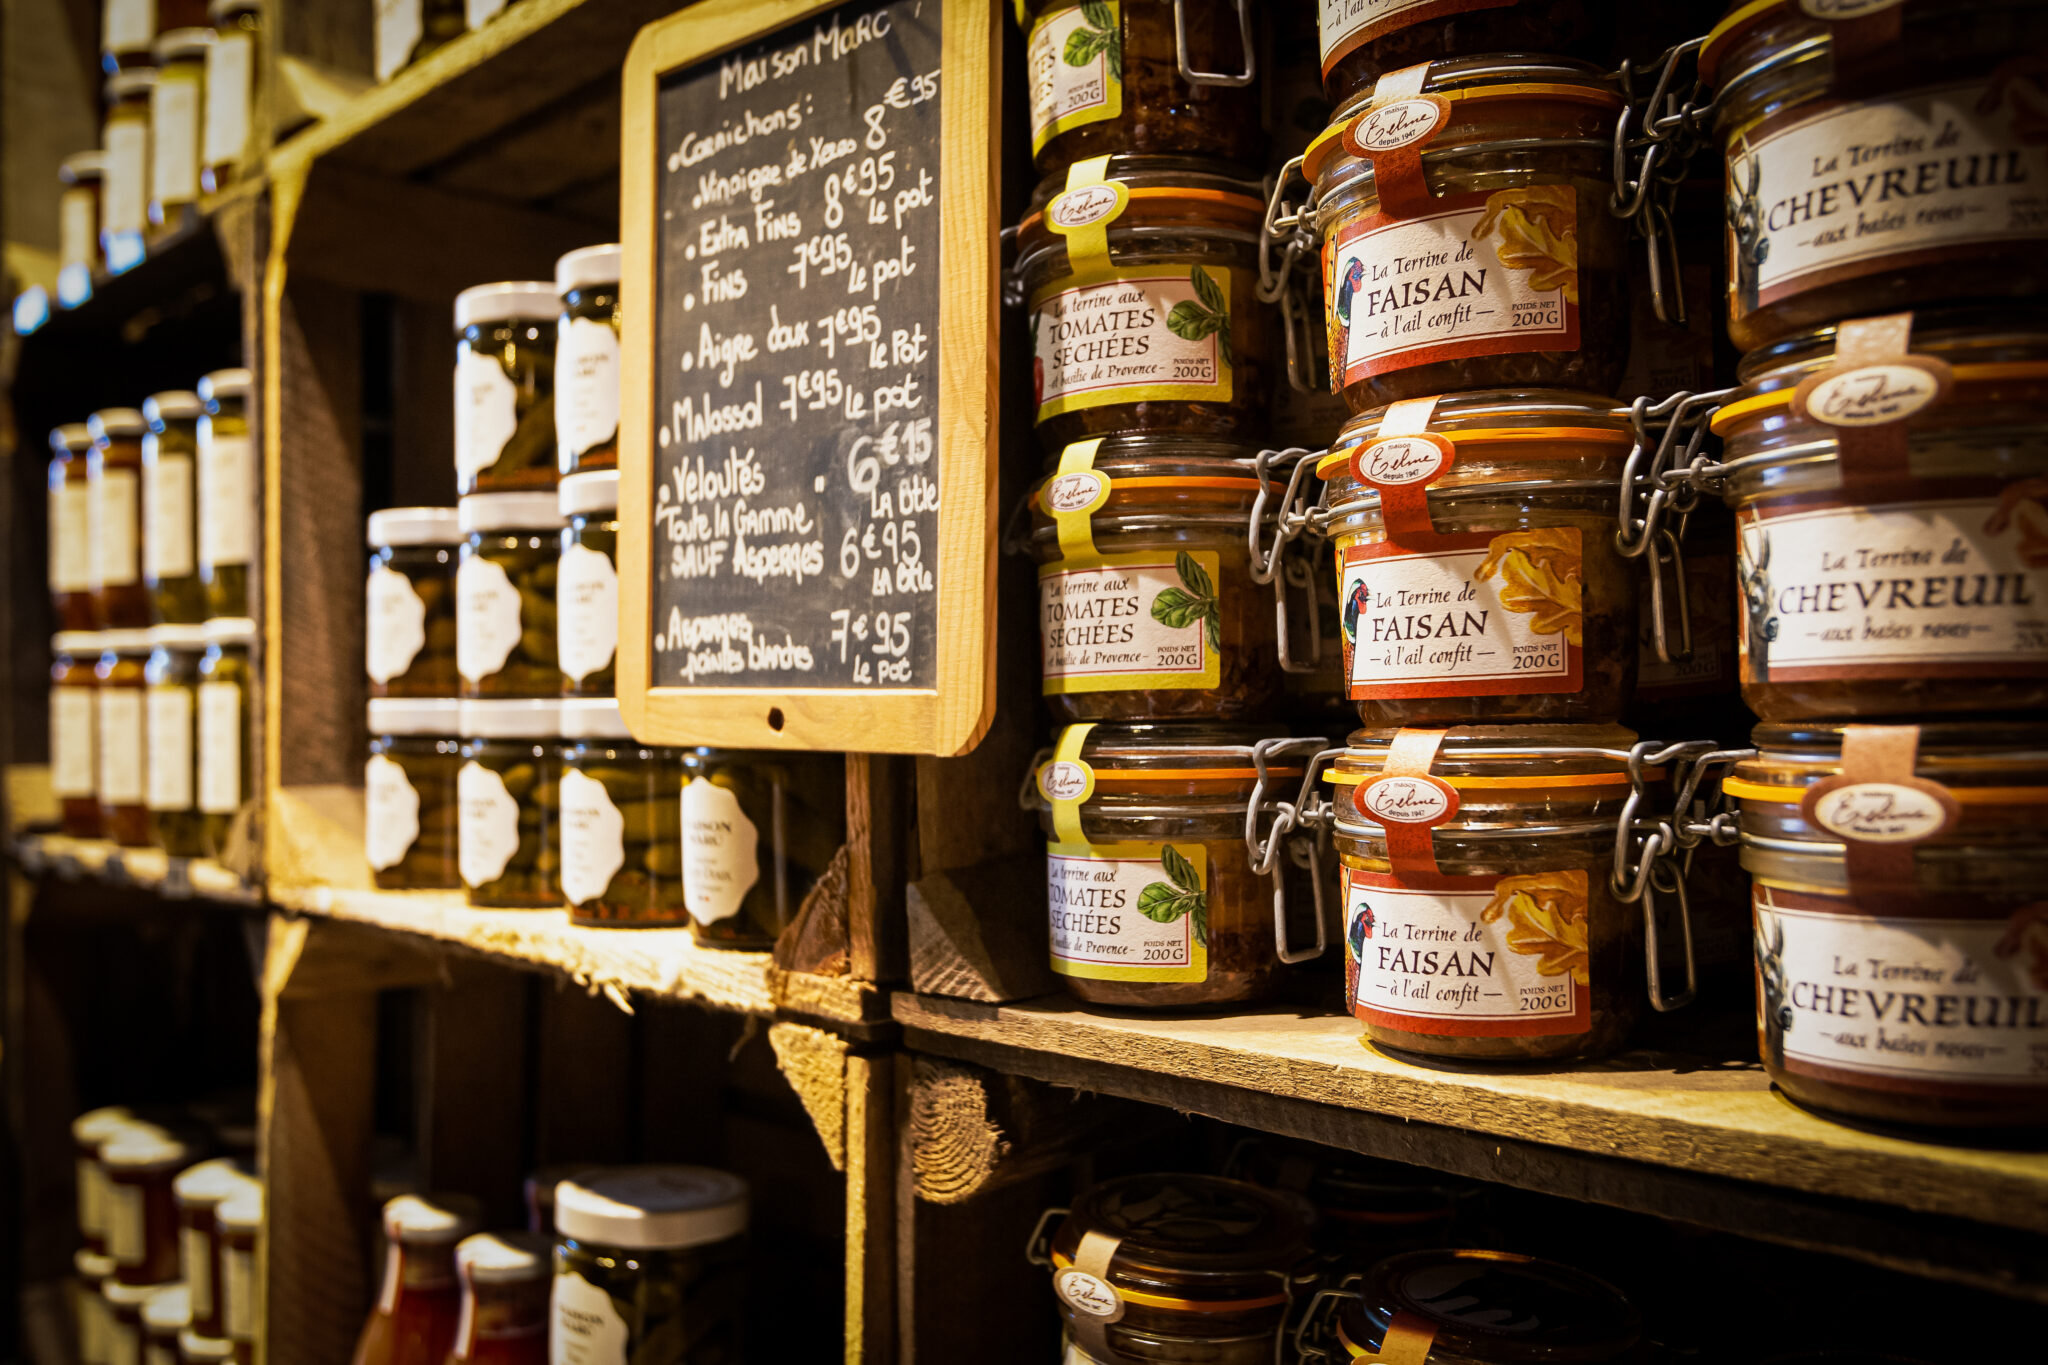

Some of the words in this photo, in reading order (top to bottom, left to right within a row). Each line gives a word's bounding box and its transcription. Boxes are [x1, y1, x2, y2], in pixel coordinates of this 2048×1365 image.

[720, 52, 808, 100] Maison
[1379, 135, 1400, 146] depuis
[1402, 129, 1416, 139] 1947
[785, 149, 808, 179] de
[1812, 156, 1839, 177] La
[894, 167, 934, 229] pot
[1767, 151, 2029, 232] CHEVREUIL
[873, 236, 916, 301] pot
[1372, 264, 1389, 282] La
[1394, 250, 1448, 276] Terrine
[1455, 240, 1474, 263] de
[1073, 292, 1113, 314] terrine
[1119, 290, 1145, 304] aux
[1367, 268, 1488, 317] FAISAN
[1049, 308, 1155, 345] TOMATES
[1428, 303, 1473, 334] confit
[698, 322, 758, 388] Aigre
[1053, 333, 1150, 370] SÉCHÉES
[1091, 366, 1102, 380] de
[873, 373, 922, 425] pot
[673, 446, 765, 504] Veloutés
[667, 504, 712, 543] Toute
[671, 539, 729, 579] SAUF
[1822, 552, 1845, 571] La
[1857, 546, 1931, 570] Terrine
[1064, 578, 1099, 596] terrine
[1104, 577, 1130, 591] aux
[1376, 592, 1393, 609] La
[1397, 586, 1450, 607] Terrine
[1457, 580, 1477, 601] de
[1779, 572, 2034, 615] CHEVREUIL
[1047, 596, 1139, 623] TOMATES
[1050, 620, 1134, 649] SÉCHÉES
[1372, 610, 1489, 642] FAISAN
[1080, 650, 1091, 665] de
[1429, 641, 1474, 671] confit
[1513, 645, 1538, 653] POIDS
[1539, 643, 1558, 651] NET
[878, 655, 912, 684] pot
[1061, 865, 1089, 881] terrine
[1094, 870, 1117, 882] aux
[1050, 883, 1126, 909] TOMATES
[1052, 906, 1121, 935] SÉCHÉES
[1382, 922, 1398, 939] La
[1404, 923, 1456, 942] Terrine
[1463, 922, 1483, 942] de
[1378, 946, 1496, 977] FAISAN
[1834, 956, 1858, 976] La
[1436, 982, 1480, 1010] confit
[1519, 986, 1545, 995] POIDS
[1546, 984, 1565, 993] NET
[1792, 982, 2048, 1029] CHEVREUIL
